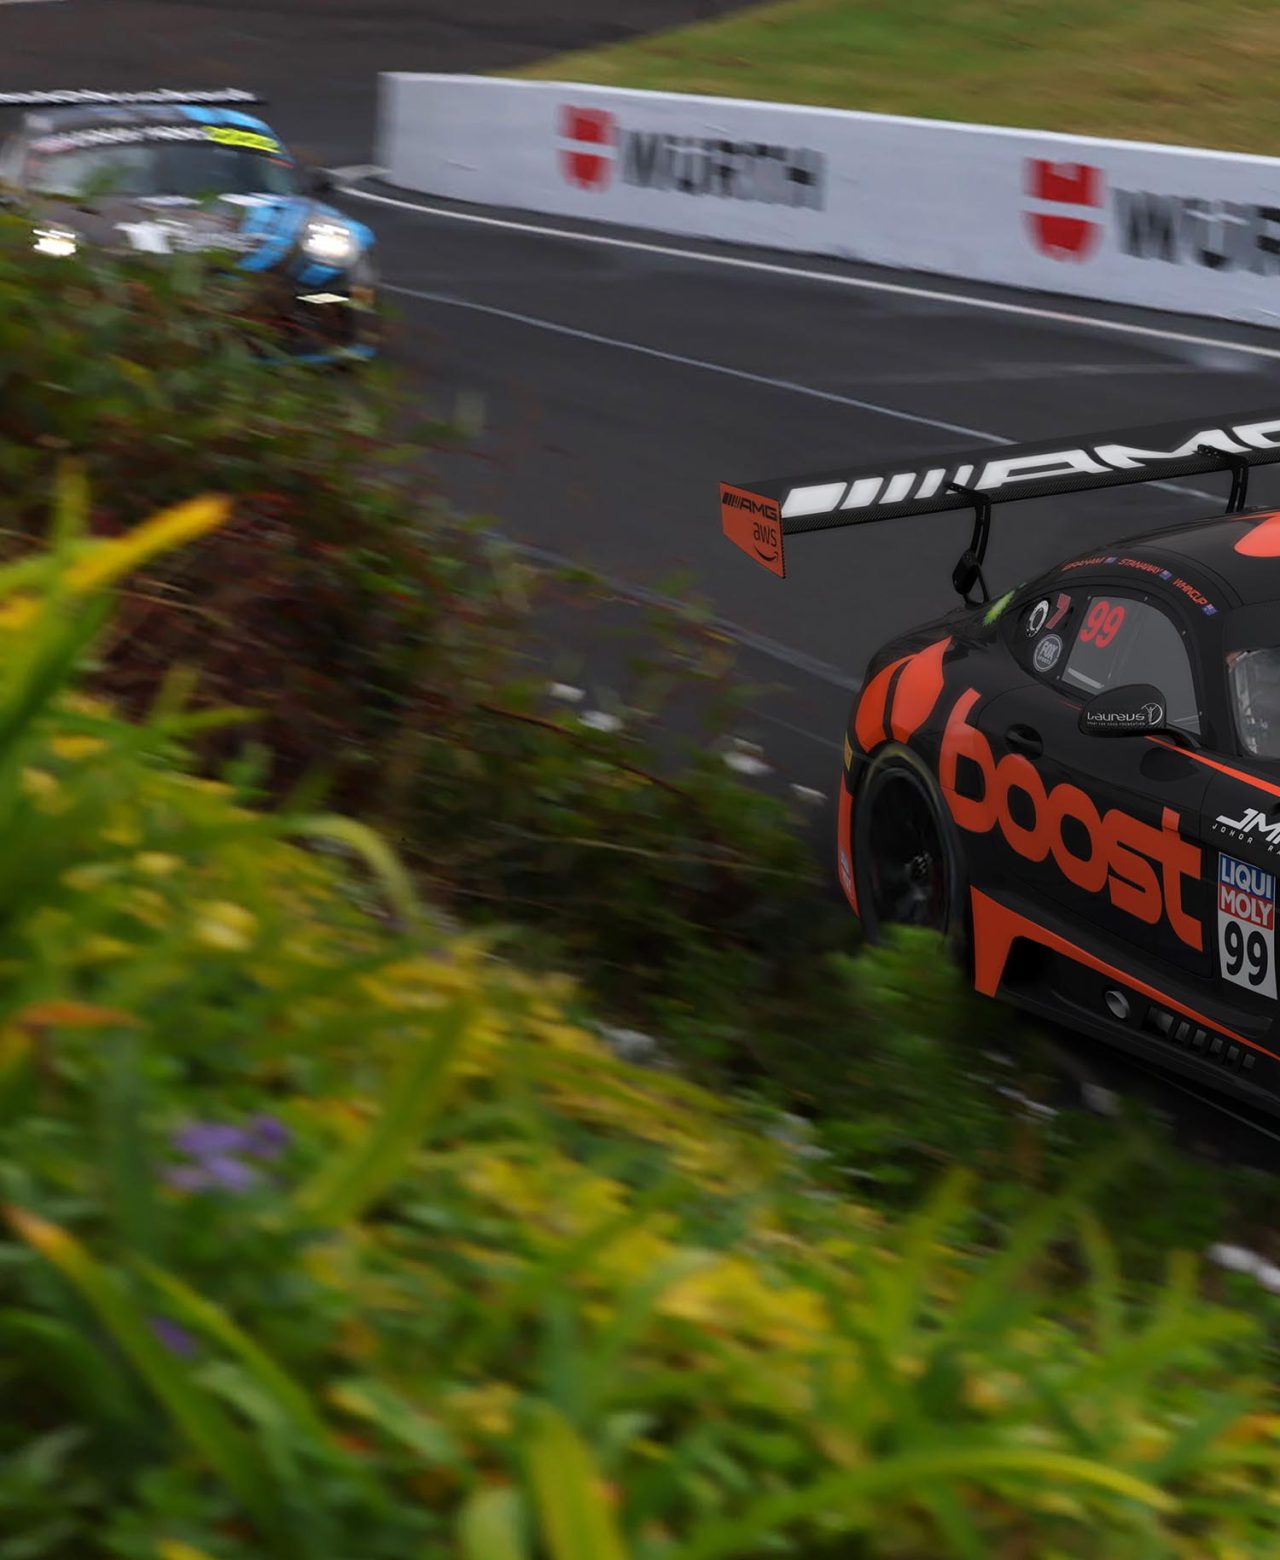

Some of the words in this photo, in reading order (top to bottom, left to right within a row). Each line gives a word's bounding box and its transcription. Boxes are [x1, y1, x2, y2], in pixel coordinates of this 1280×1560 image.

[620, 127, 826, 210] WÜRTH
[753, 522, 778, 549] aws
[1080, 600, 1125, 647] 99
[1088, 711, 1145, 722] Laureus
[939, 687, 1204, 952] boost
[1221, 856, 1272, 899] LIQUI
[1220, 886, 1273, 926] MOLY
[1224, 920, 1268, 986] 99
